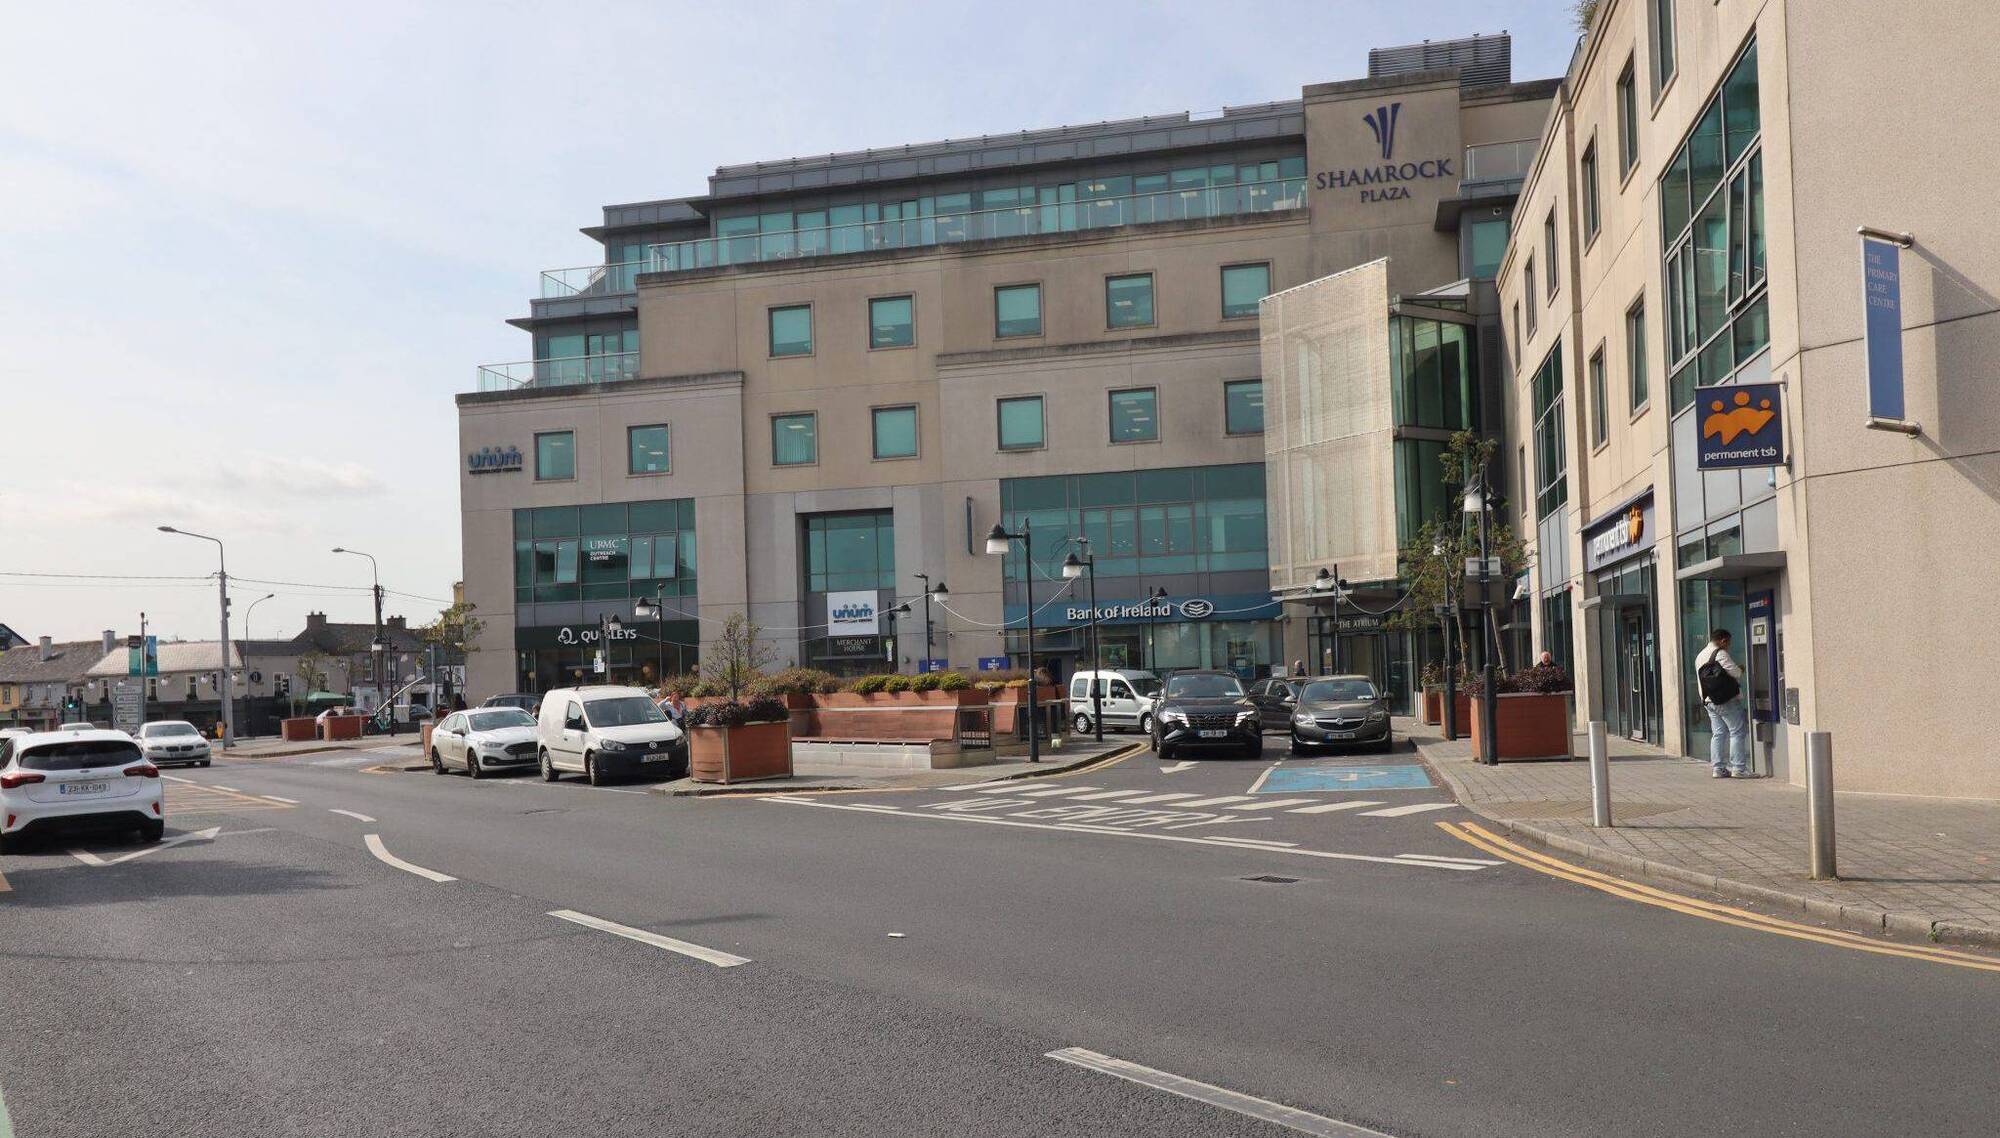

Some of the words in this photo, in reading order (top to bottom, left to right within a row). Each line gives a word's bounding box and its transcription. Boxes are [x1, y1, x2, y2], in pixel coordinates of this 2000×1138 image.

[1316, 158, 1454, 190] SHAMROCK
[1360, 186, 1410, 203] PLAZA
[1867, 266, 1898, 281] PRIMARY
[1868, 281, 1888, 295] CARE
[1868, 295, 1896, 311] CENTRE
[1704, 448, 1760, 462] permanent
[1761, 445, 1777, 457] tsb
[1066, 606, 1103, 620] Bank
[1104, 605, 1120, 618] of
[1121, 603, 1171, 618] Ireland
[918, 797, 1037, 812] NO
[1006, 804, 1274, 830] ENTRY
